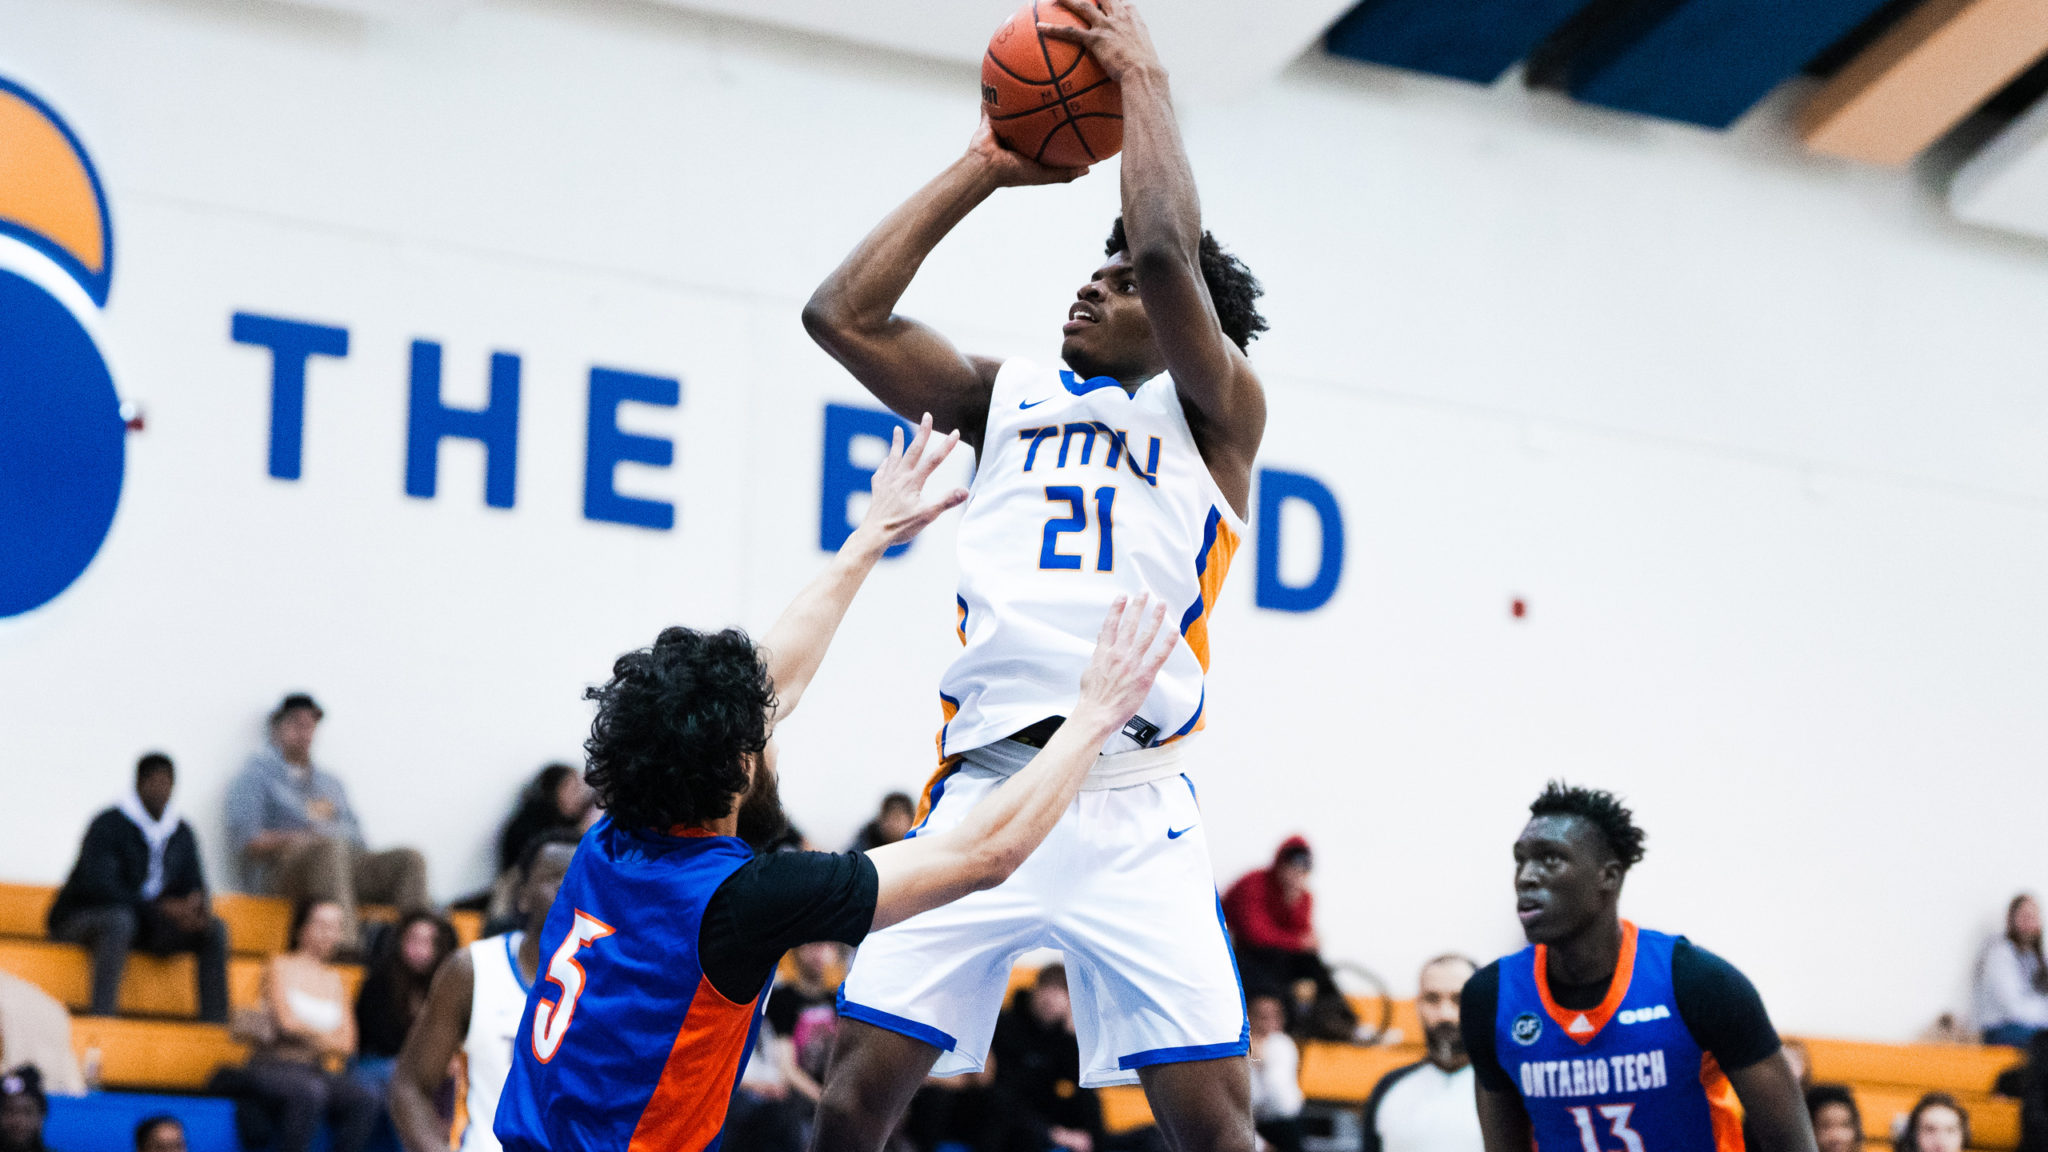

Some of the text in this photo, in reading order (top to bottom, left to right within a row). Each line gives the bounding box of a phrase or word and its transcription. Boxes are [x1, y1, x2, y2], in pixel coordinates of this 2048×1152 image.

[231, 311, 1344, 613] THE BD
[1018, 420, 1163, 488] TMU
[1037, 483, 1118, 575] 21
[531, 907, 617, 1065] 5
[1520, 1049, 1668, 1098] ONTARIO TECH
[1566, 1103, 1647, 1152] 13
